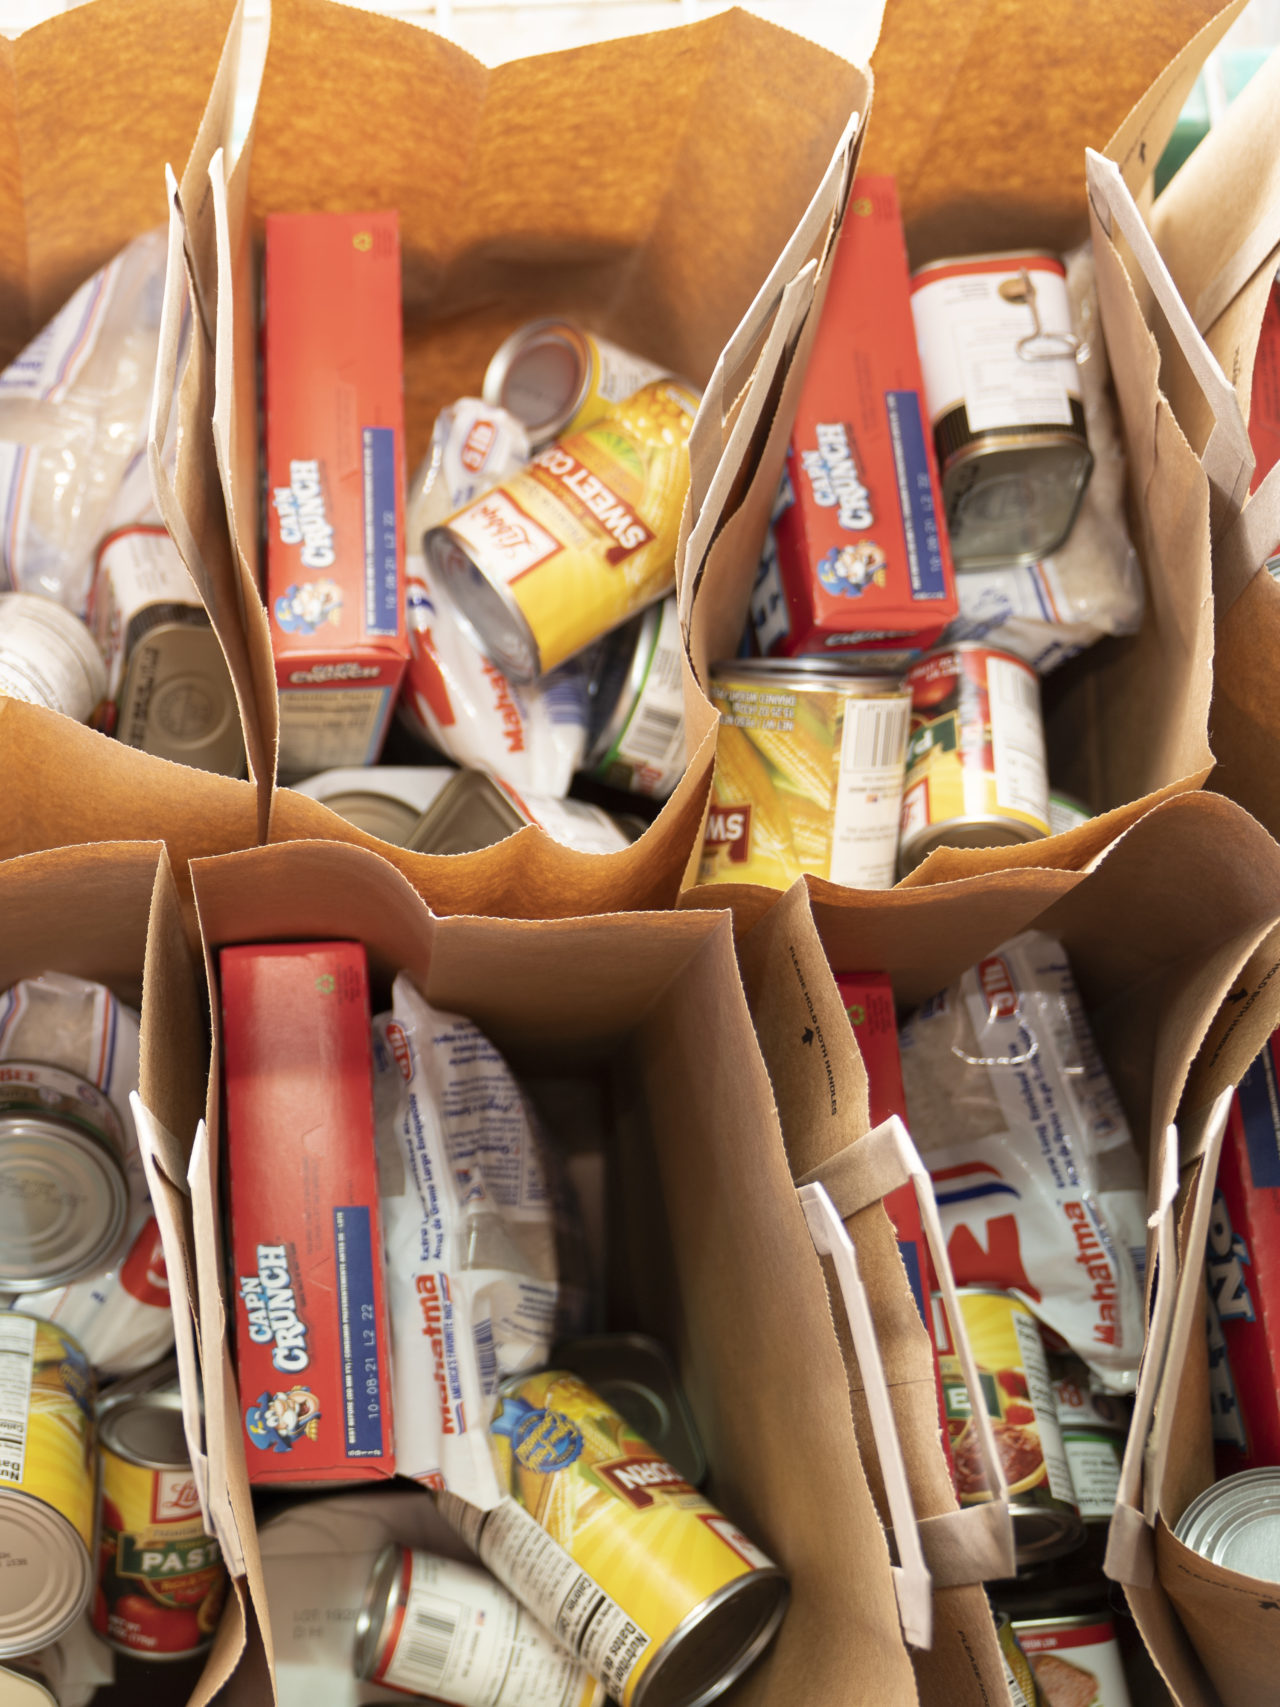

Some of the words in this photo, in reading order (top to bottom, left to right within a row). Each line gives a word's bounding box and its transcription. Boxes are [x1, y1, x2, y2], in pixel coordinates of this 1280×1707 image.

[816, 422, 874, 531] CRUNCH
[288, 460, 336, 570] CRUNCH
[566, 469, 651, 553] SWEET
[786, 945, 808, 989] PLEASE
[802, 991, 820, 1025] HOLD
[812, 1025, 831, 1058] BOTH
[824, 1059, 838, 1116] HANDLES
[421, 1155, 433, 1181] Largo
[428, 1185, 438, 1215] Grano
[338, 1232, 345, 1241] DE
[432, 1218, 441, 1229] de
[420, 1229, 429, 1261] Extra
[1063, 1201, 1121, 1348] Mahatma
[239, 1276, 272, 1342] CAP'N
[257, 1245, 309, 1372] CRUNCH
[340, 1263, 349, 1323] PREFERENTEMENTE
[362, 1304, 373, 1320] 22
[343, 1323, 351, 1357] CONSUMIR
[363, 1330, 375, 1345] L2
[346, 1374, 352, 1387] MM
[143, 1546, 220, 1572] PAST
[608, 1621, 638, 1658] Datos
